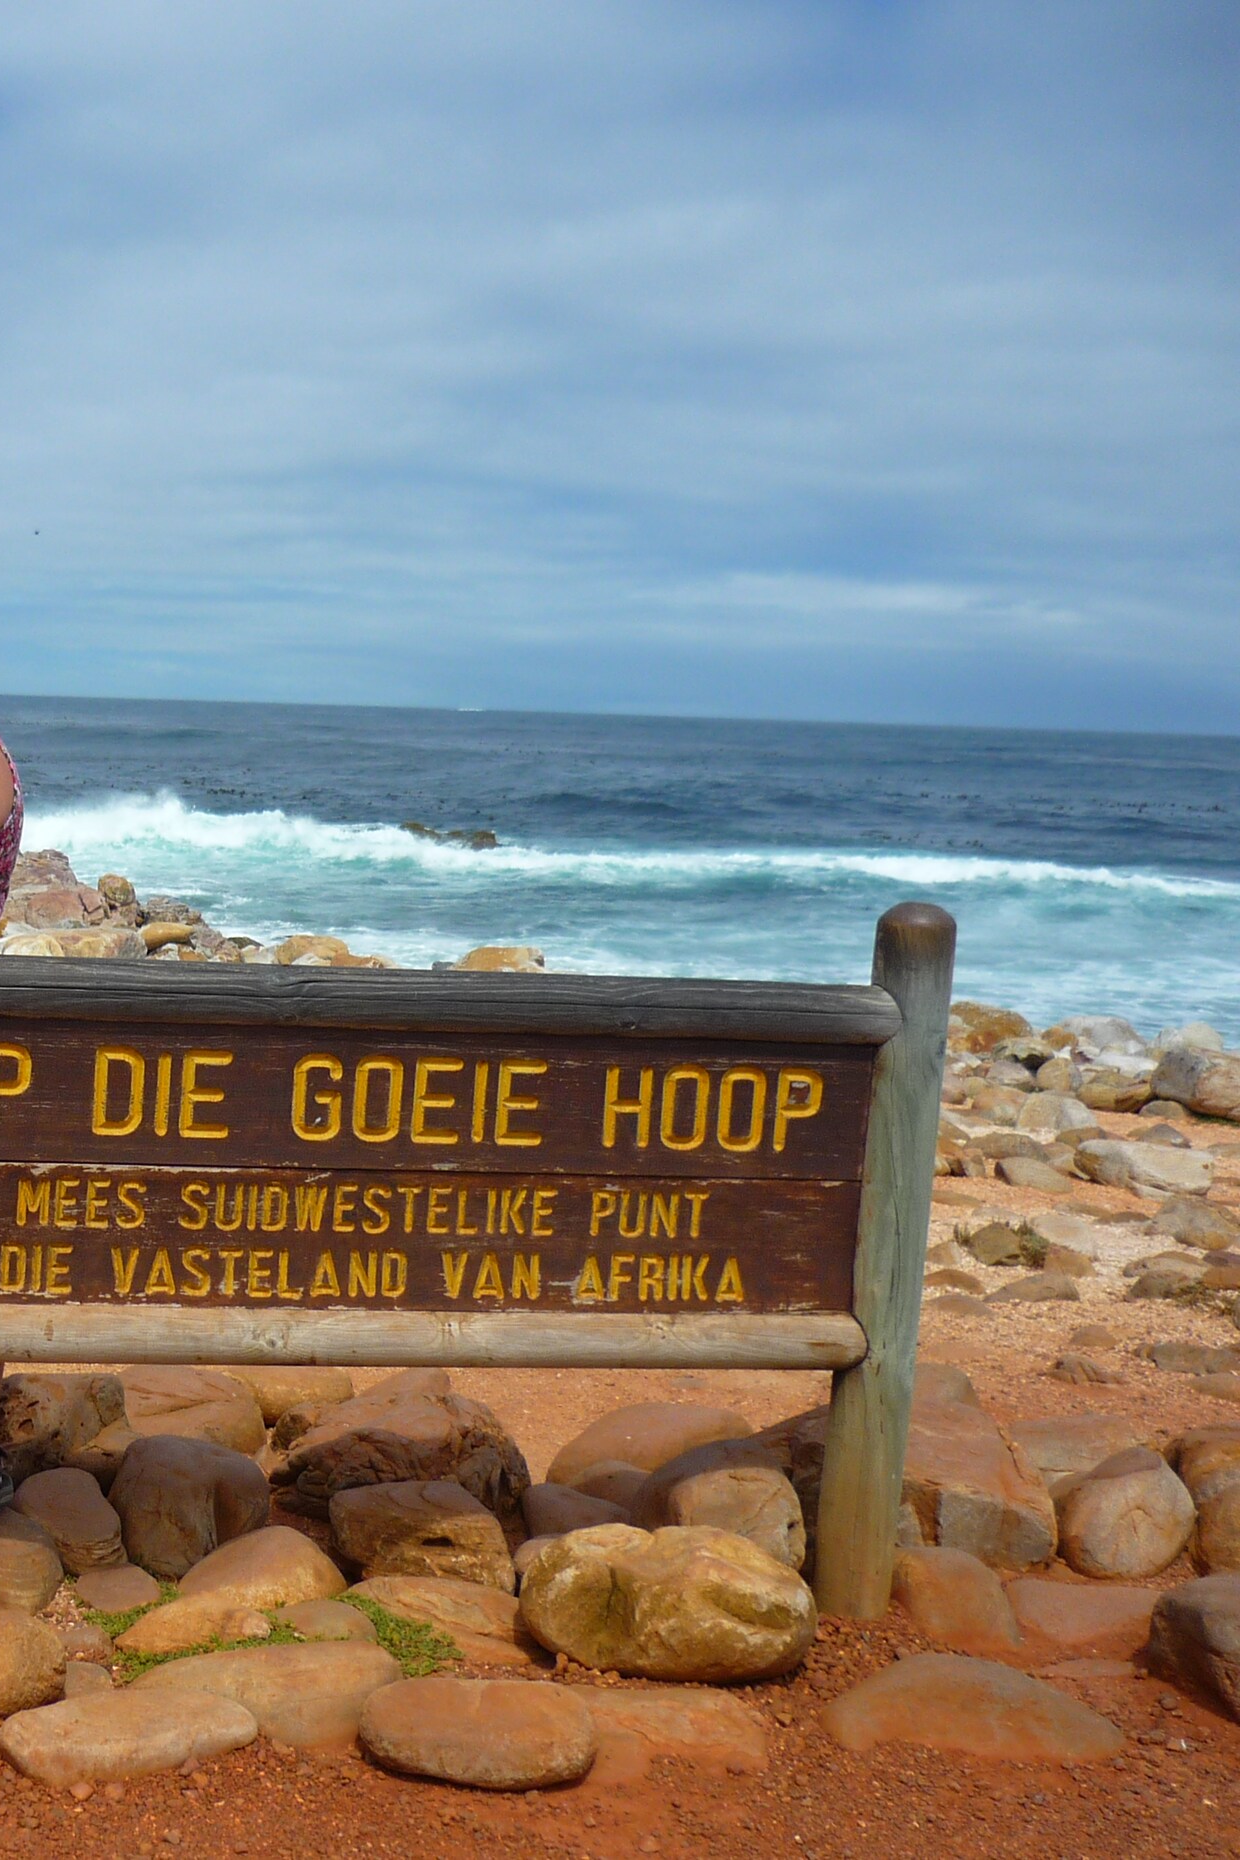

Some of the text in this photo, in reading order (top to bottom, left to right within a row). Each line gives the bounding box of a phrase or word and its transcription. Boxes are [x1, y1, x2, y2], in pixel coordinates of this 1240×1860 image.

[91, 1045, 234, 1139] DIE
[291, 1053, 549, 1147] GOEIE
[601, 1063, 825, 1152] HOOP
[16, 1174, 146, 1230] MEES
[177, 1179, 559, 1238] SUIDWESTELIKE
[589, 1187, 710, 1239] PUNT
[110, 1245, 409, 1300] VASTELAND
[441, 1250, 541, 1301] VAN
[575, 1252, 746, 1304] AFRIKA
